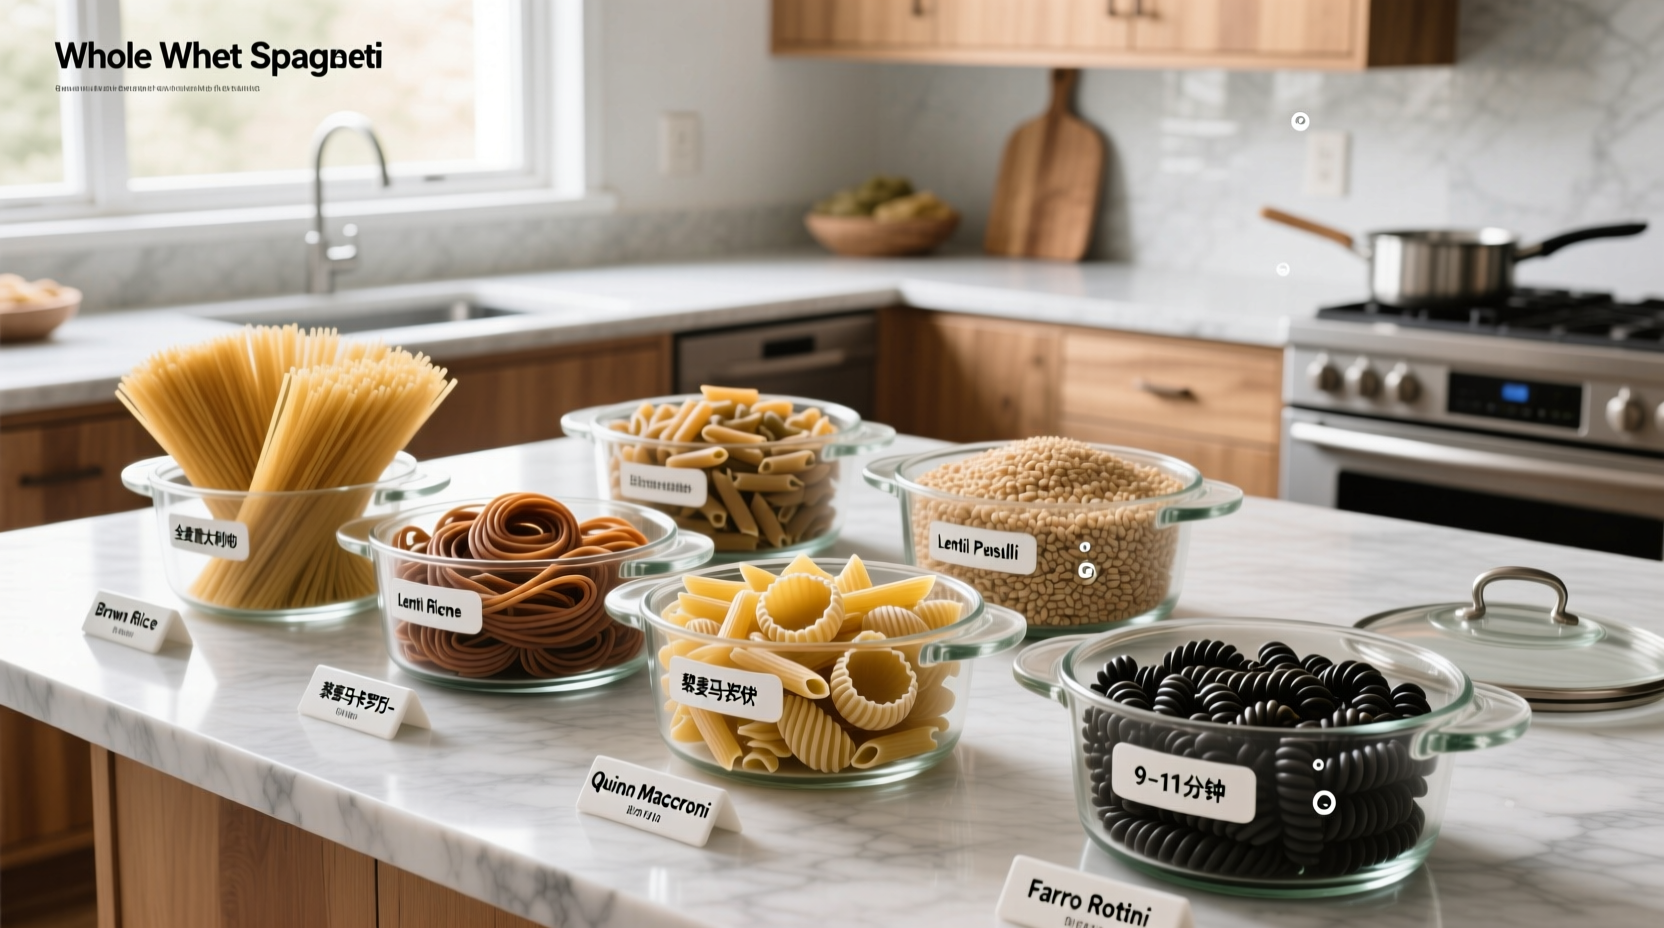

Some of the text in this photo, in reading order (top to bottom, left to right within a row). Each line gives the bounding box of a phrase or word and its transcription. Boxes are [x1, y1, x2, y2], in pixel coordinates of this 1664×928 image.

[938, 533, 970, 554] Lentil
[591, 770, 636, 798] Quinn
[1134, 764, 1226, 804] 9-11分钟
[1028, 879, 1153, 928] Farro Rotini
